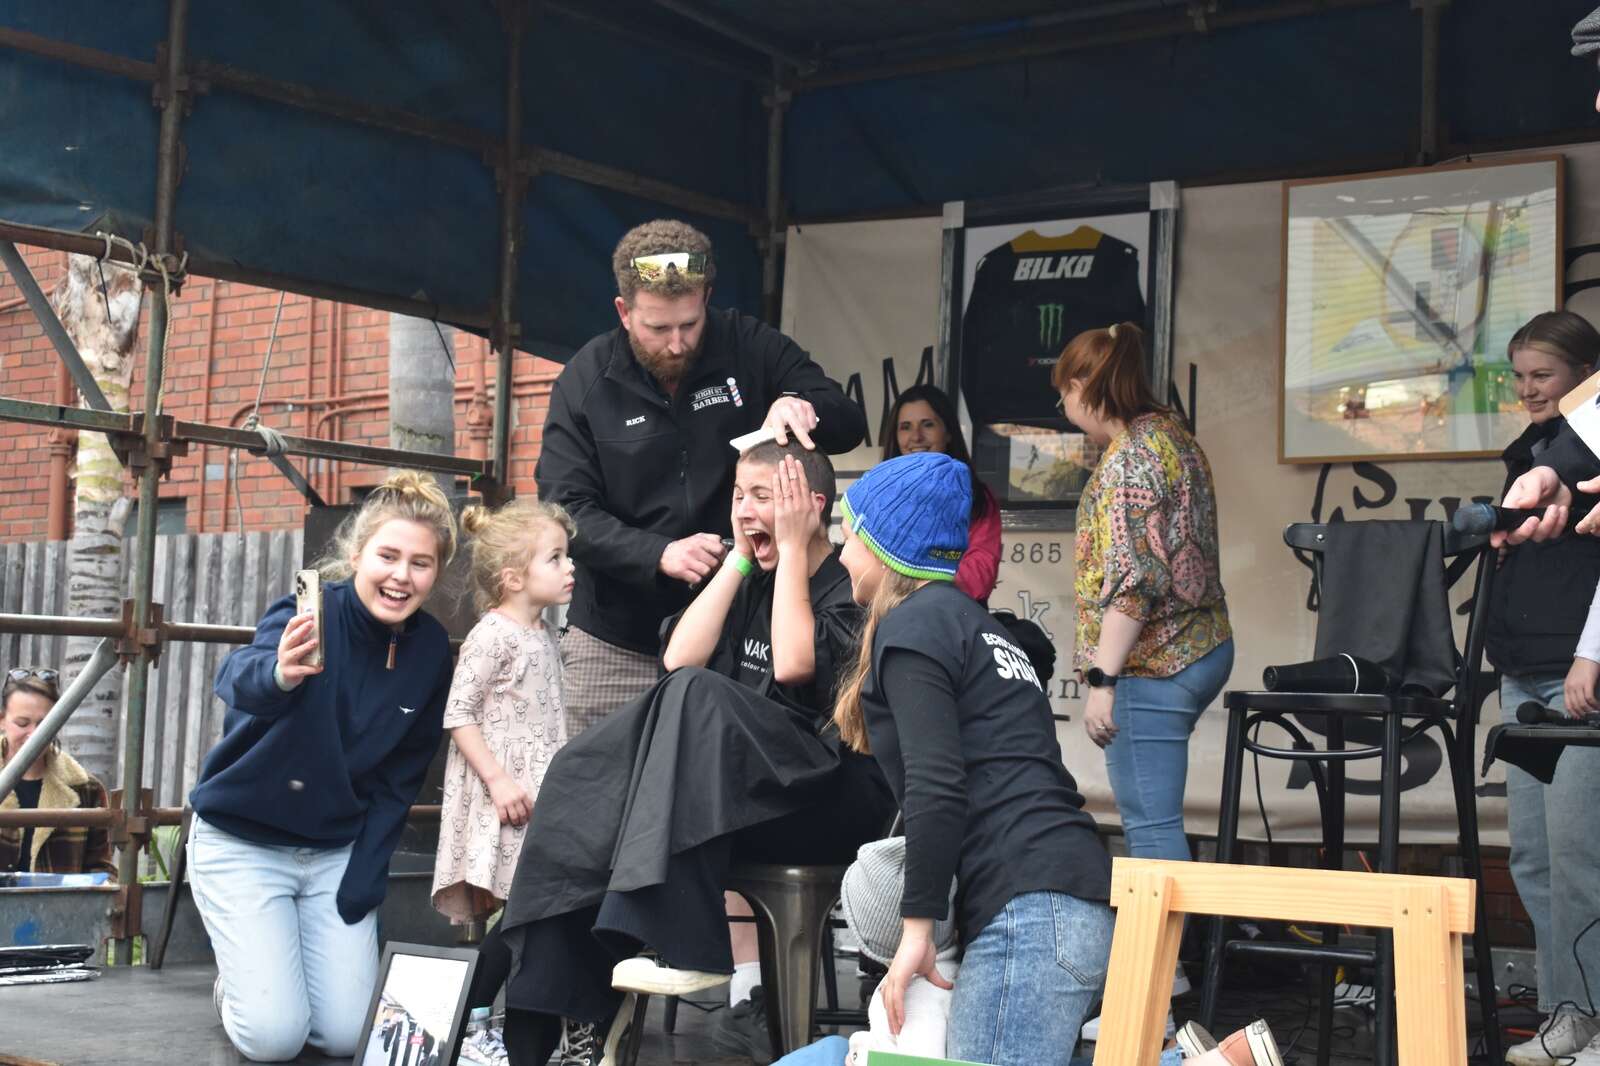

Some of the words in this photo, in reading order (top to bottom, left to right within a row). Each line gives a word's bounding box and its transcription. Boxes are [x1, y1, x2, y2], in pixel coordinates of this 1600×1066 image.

[1013, 255, 1095, 281] BILKO
[692, 395, 730, 410] BARBER
[625, 415, 646, 426] RICK
